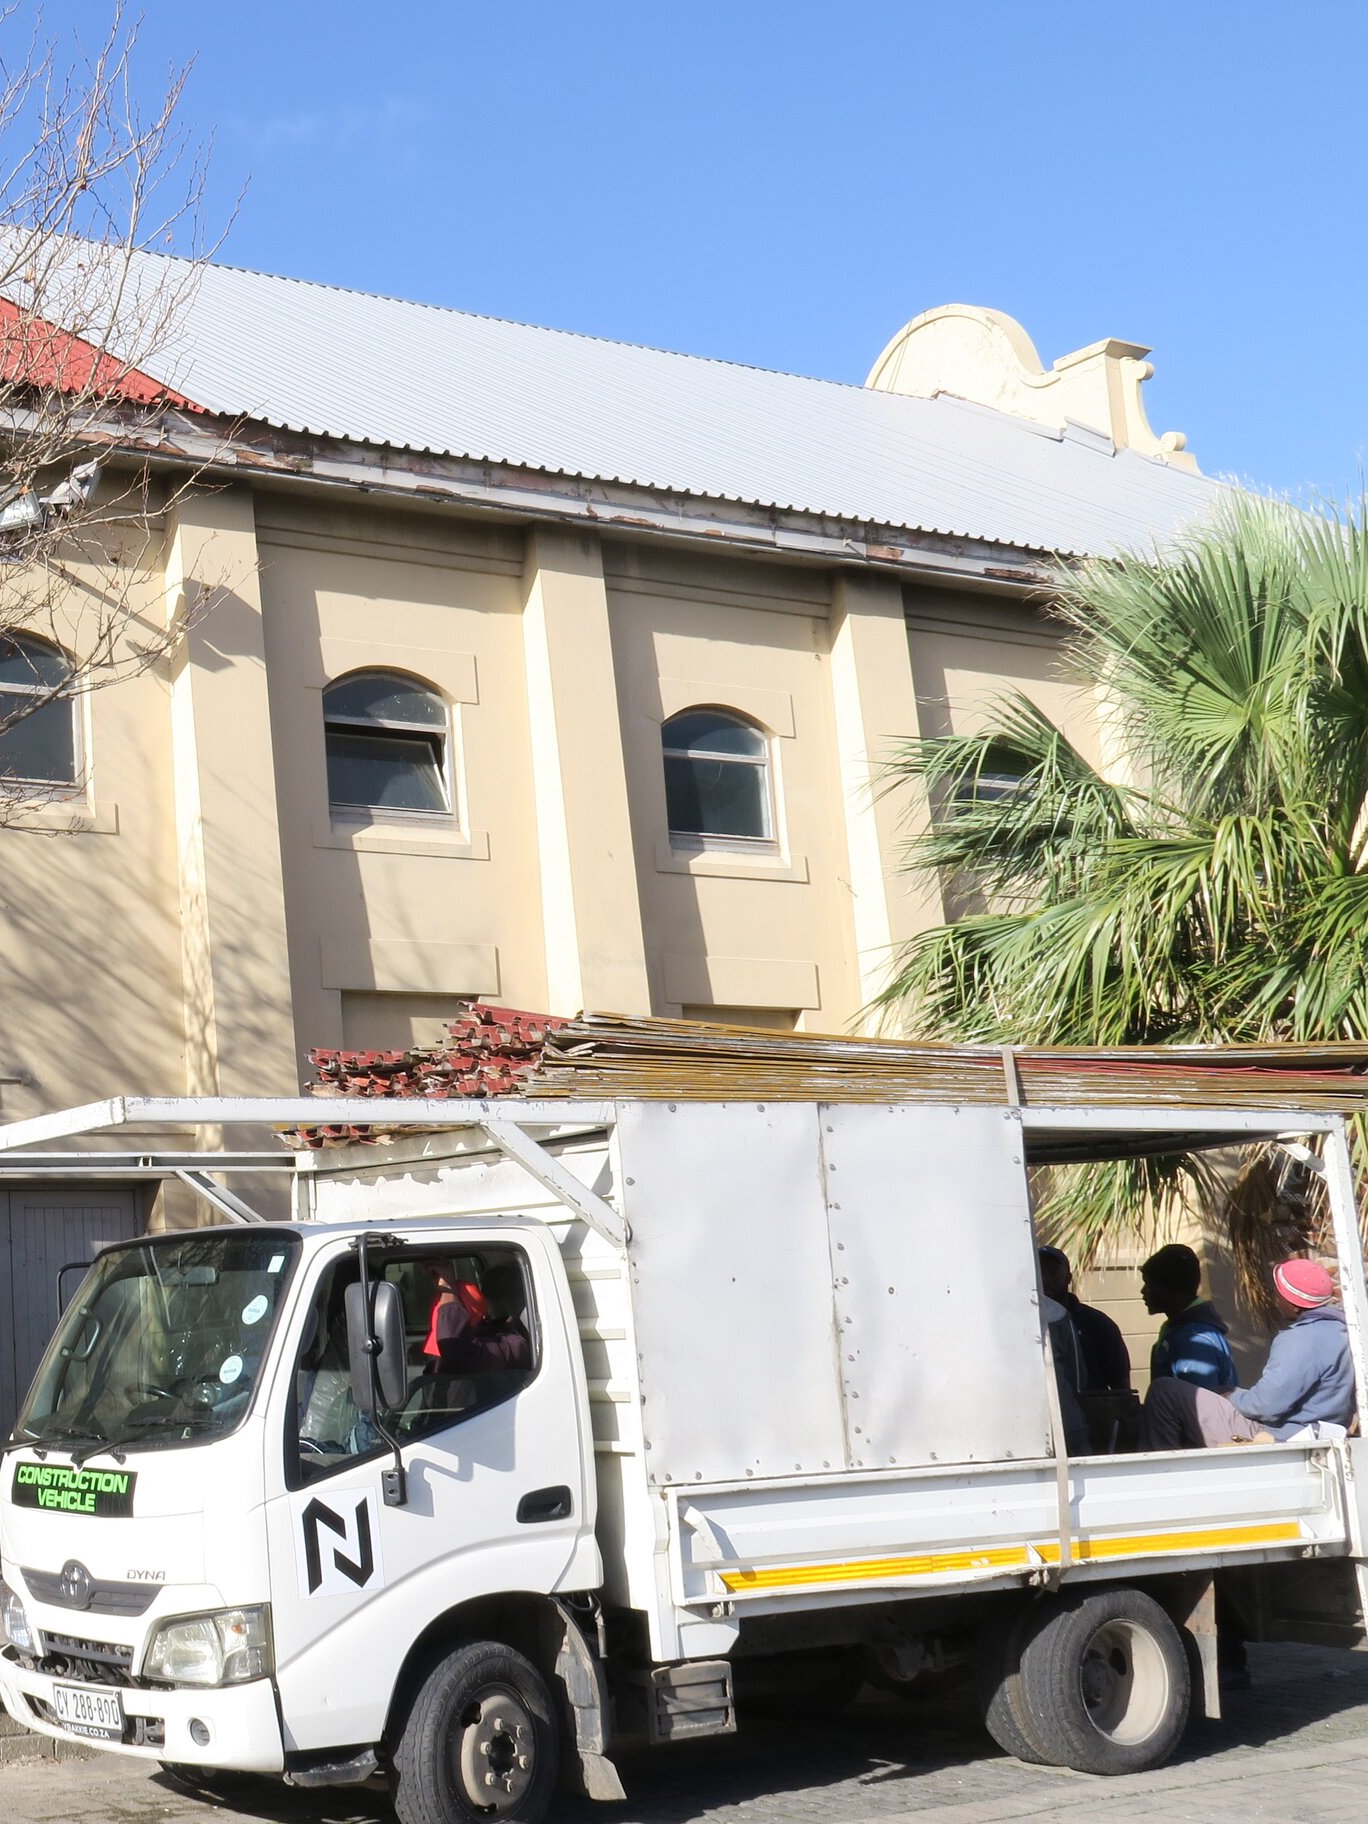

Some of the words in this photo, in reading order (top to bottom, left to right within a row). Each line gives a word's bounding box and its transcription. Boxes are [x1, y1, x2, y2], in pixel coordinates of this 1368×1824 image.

[17, 1465, 128, 1494] CONSTRUCTION
[37, 1487, 96, 1512] VEHICLE
[126, 1568, 166, 1581] DYNA
[56, 1690, 69, 1716] CY
[72, 1693, 119, 1726] 288-890
